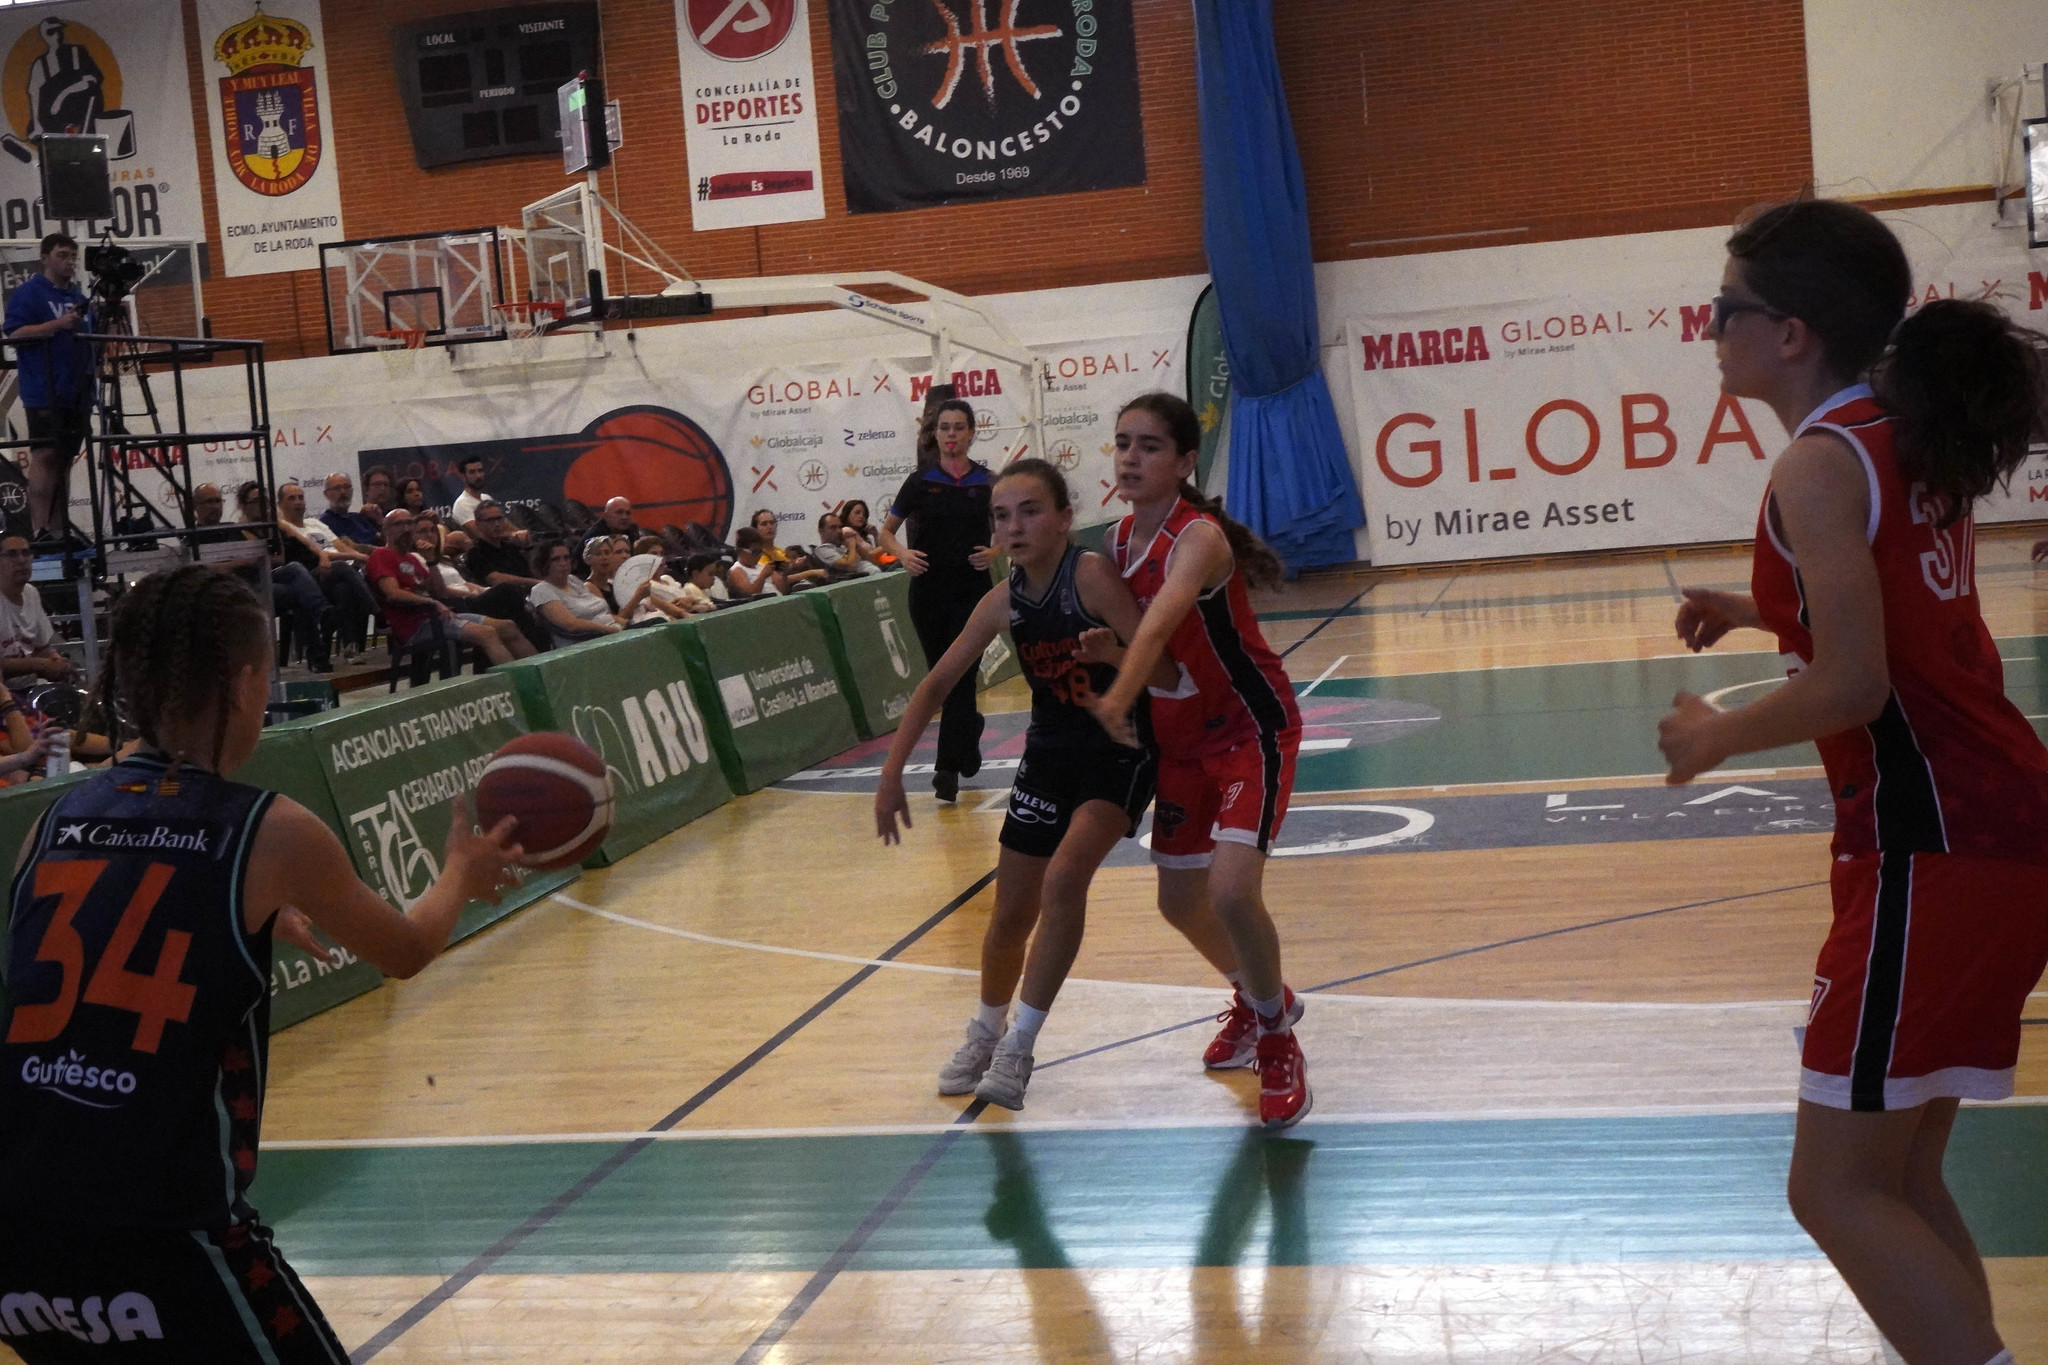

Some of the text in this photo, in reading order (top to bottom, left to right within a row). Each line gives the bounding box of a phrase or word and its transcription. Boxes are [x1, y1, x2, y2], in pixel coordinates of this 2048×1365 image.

[426, 33, 456, 46] LOCAL
[519, 19, 565, 33] VISITANTE
[867, 32, 898, 99] CLUB
[479, 86, 515, 99] PERIODO
[696, 78, 801, 98] CONCEJALÍA DE
[696, 92, 804, 125] DEPORTES
[243, 123, 257, 141] R
[723, 130, 781, 146] La Roda
[899, 95, 1081, 160] BALONCESTO
[956, 166, 1030, 185] Desde 1969
[261, 215, 338, 234] AYUNTAMIENTO
[254, 237, 314, 253] DE LA RODA
[1362, 325, 1490, 371] MARCA
[1502, 310, 1632, 344] GLOBAL
[1518, 346, 1546, 357] Mirae
[1548, 343, 1576, 355] Asset
[748, 377, 861, 405] GLOBAL
[767, 429, 896, 449] Globalcaja zelenza
[1375, 391, 1766, 489] GLOBA
[1386, 498, 1635, 546] by Mirae Asset
[749, 655, 814, 691] Universidad de
[331, 691, 515, 774] AGENCIA DE TRANSPORTES
[621, 680, 709, 787] ARU
[402, 765, 466, 813] GERARDO
[1012, 785, 1056, 814] PULEVA
[88, 824, 210, 852] CaixaBank
[5, 859, 198, 1055] 34
[279, 959, 312, 990] La
